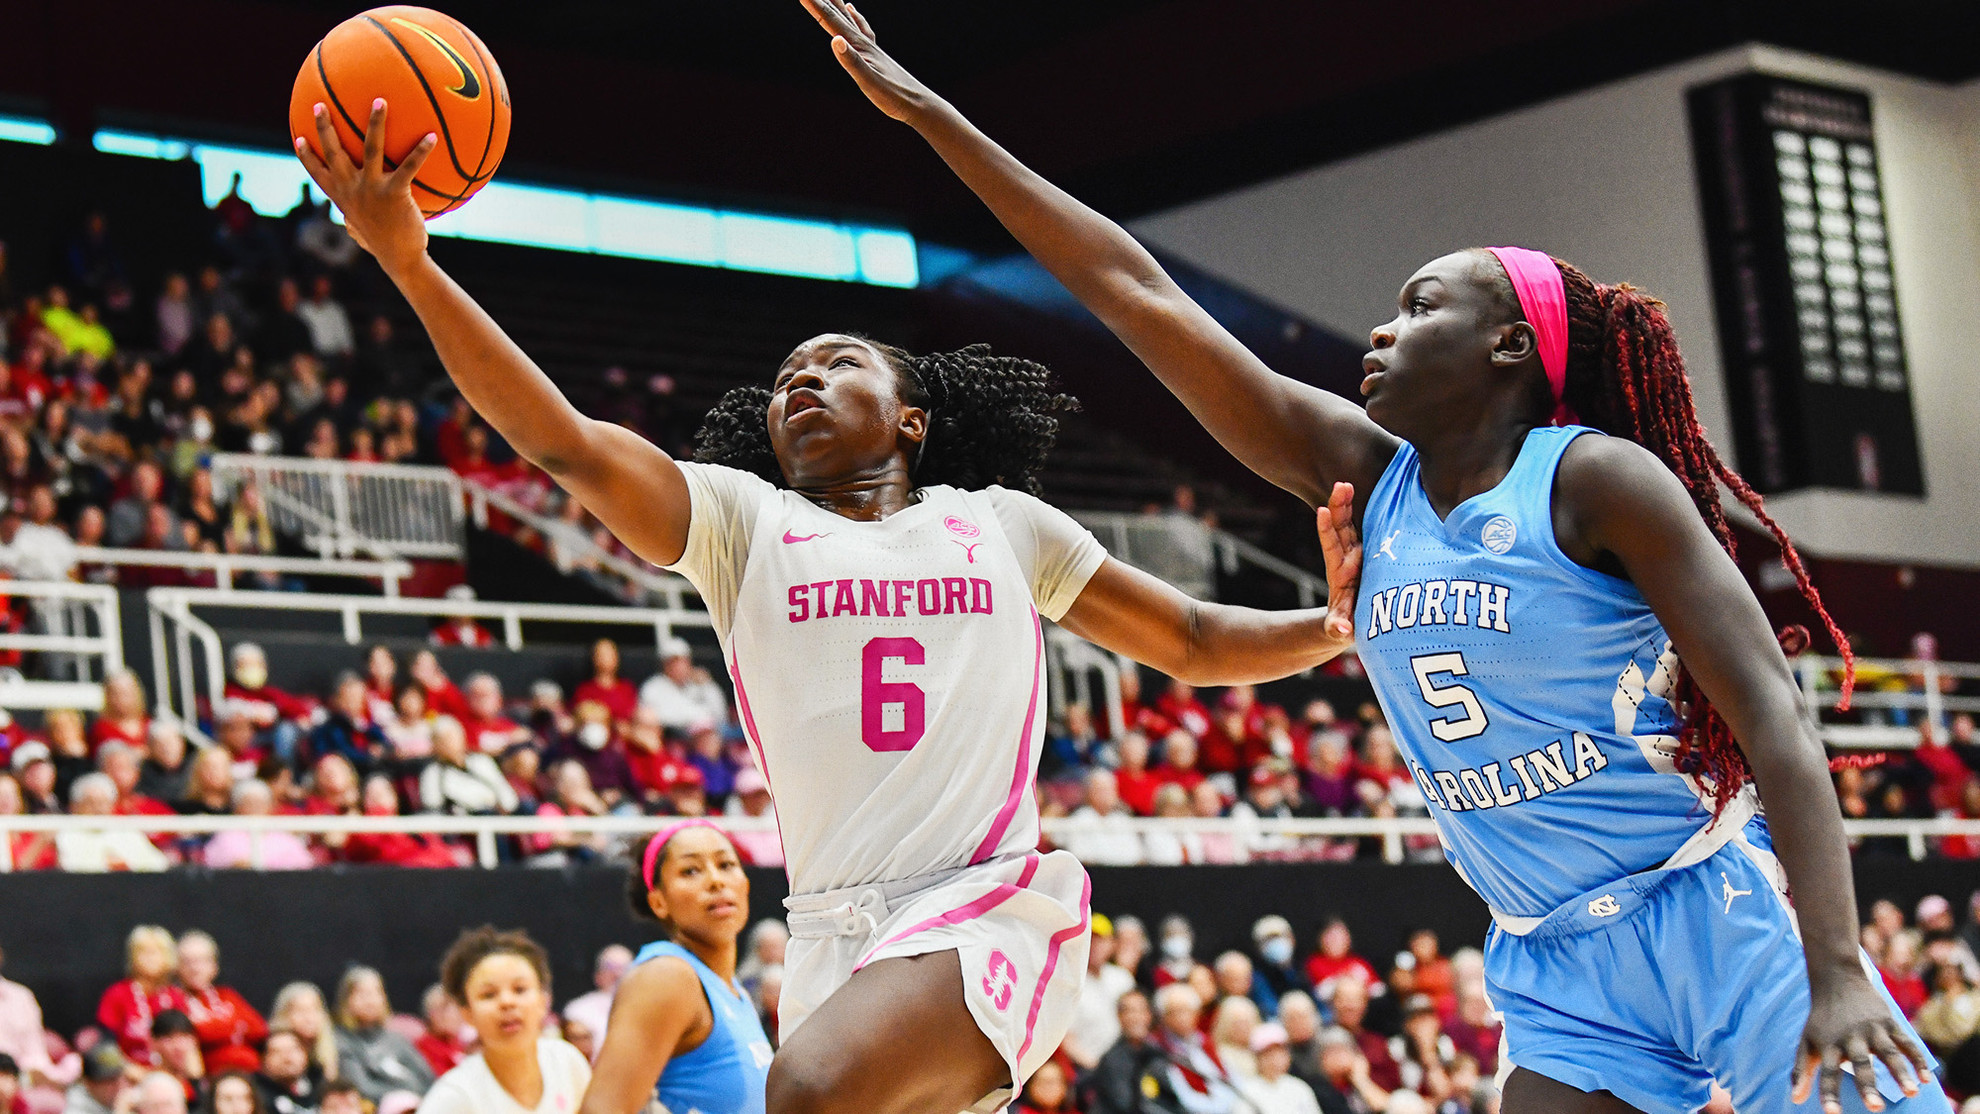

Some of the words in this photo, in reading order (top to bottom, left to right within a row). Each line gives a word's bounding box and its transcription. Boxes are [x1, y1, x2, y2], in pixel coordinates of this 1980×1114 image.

[788, 577, 993, 623] STANFORD
[1368, 579, 1510, 640] NORTH
[862, 637, 925, 752] 6
[1410, 651, 1489, 742] 5
